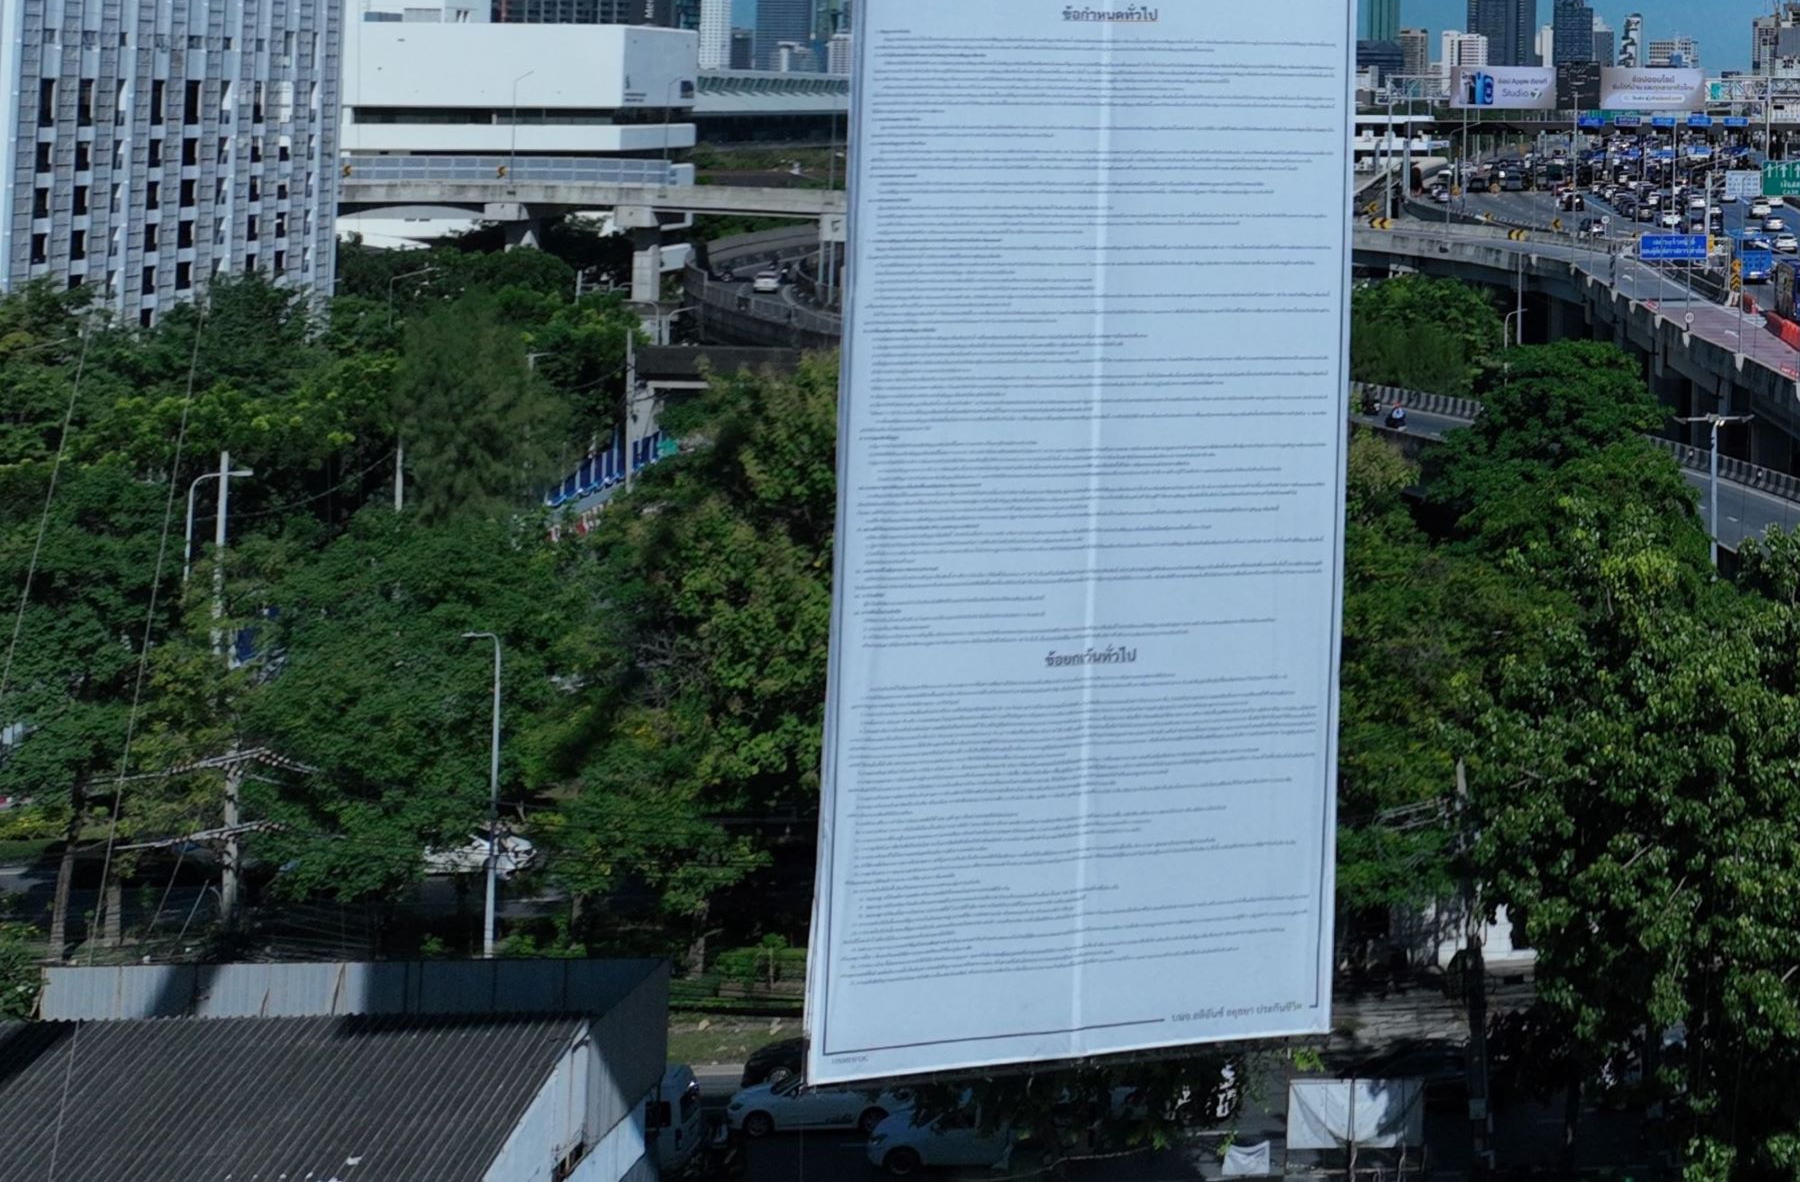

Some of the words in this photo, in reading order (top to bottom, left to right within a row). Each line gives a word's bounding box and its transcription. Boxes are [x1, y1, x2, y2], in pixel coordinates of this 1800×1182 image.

[1062, 3, 1158, 22] ข้อกำหนดทั่วไป
[1045, 643, 1137, 667] ข้อยกเว้นทั่วไป
